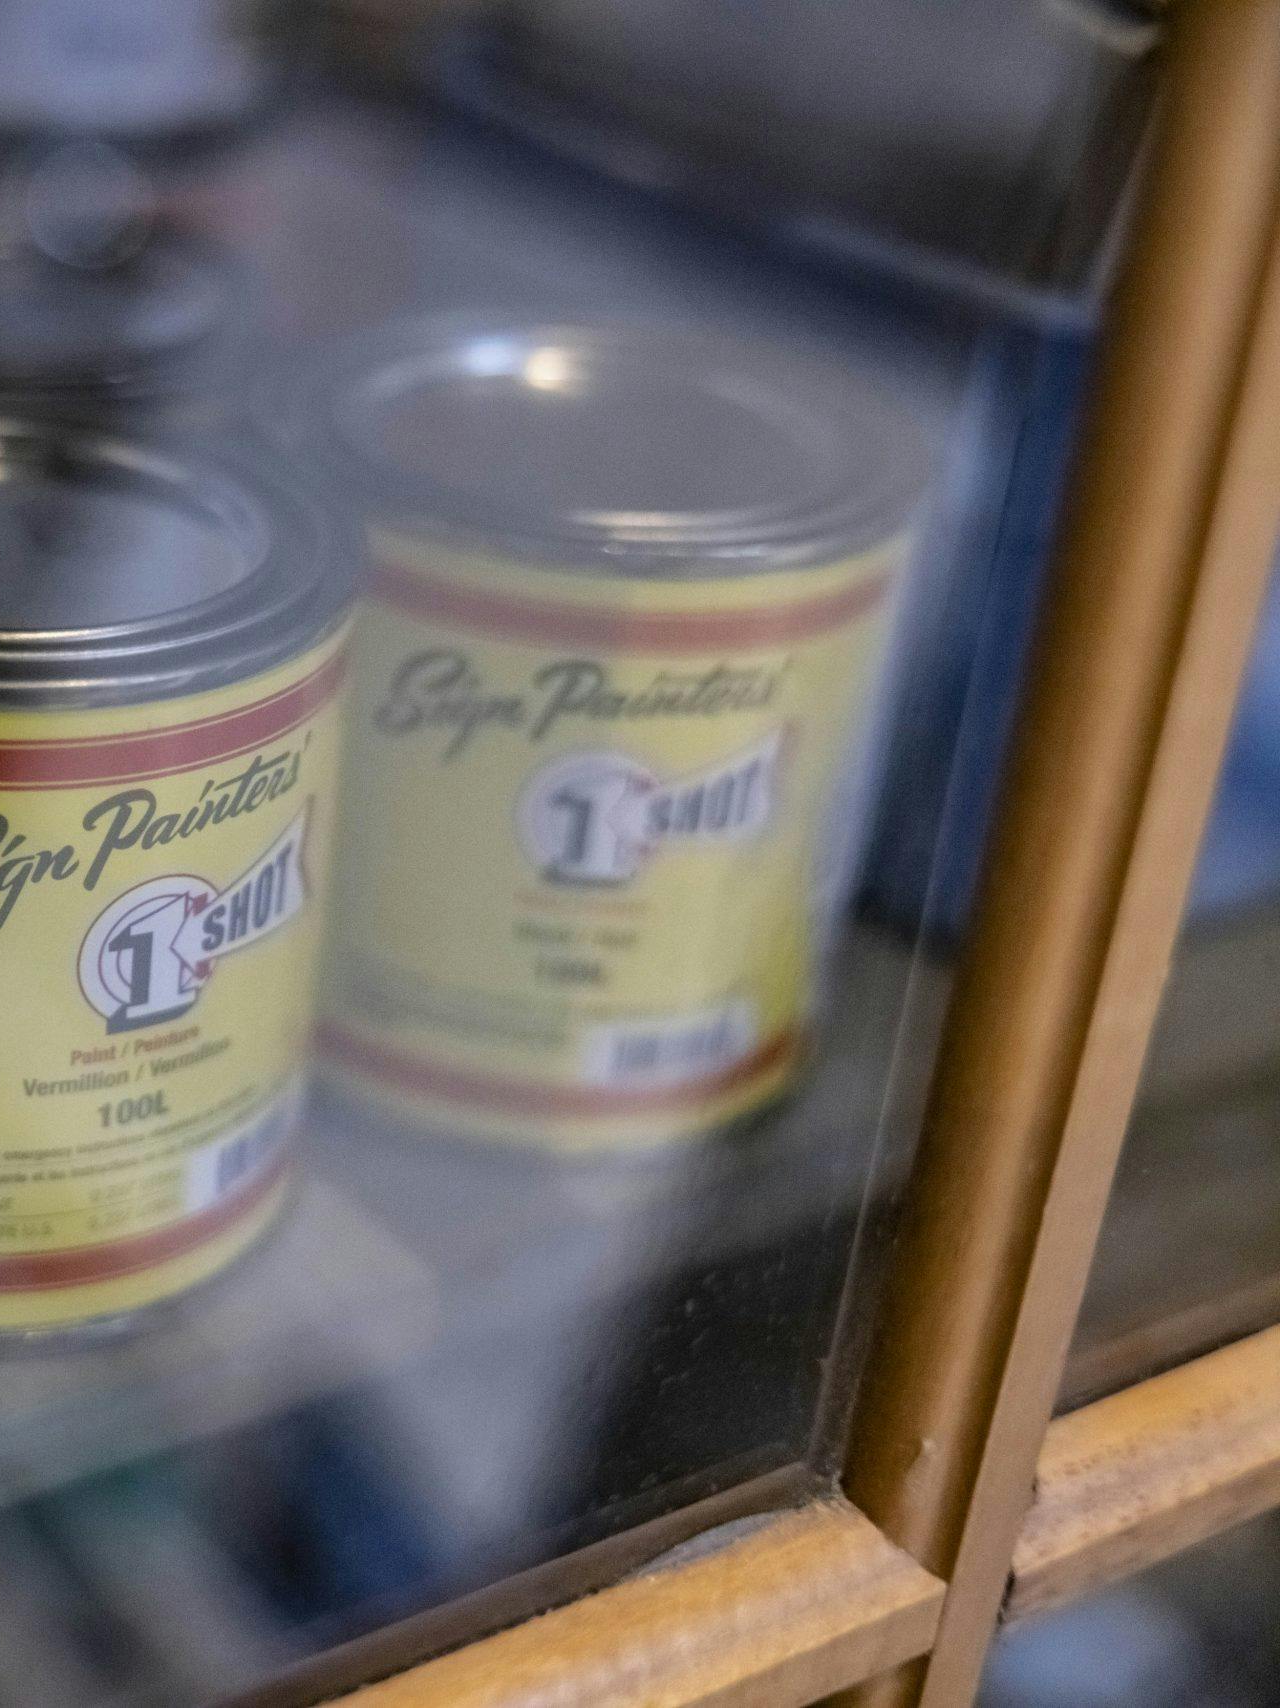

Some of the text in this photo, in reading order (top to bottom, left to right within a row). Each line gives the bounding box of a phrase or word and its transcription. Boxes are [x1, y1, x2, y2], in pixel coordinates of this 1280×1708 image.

[81, 730, 314, 891] Painters'
[201, 838, 295, 953] SHOT
[70, 1046, 117, 1066] Paint
[23, 1069, 130, 1097] Vermillion
[98, 1091, 169, 1128] 100L
